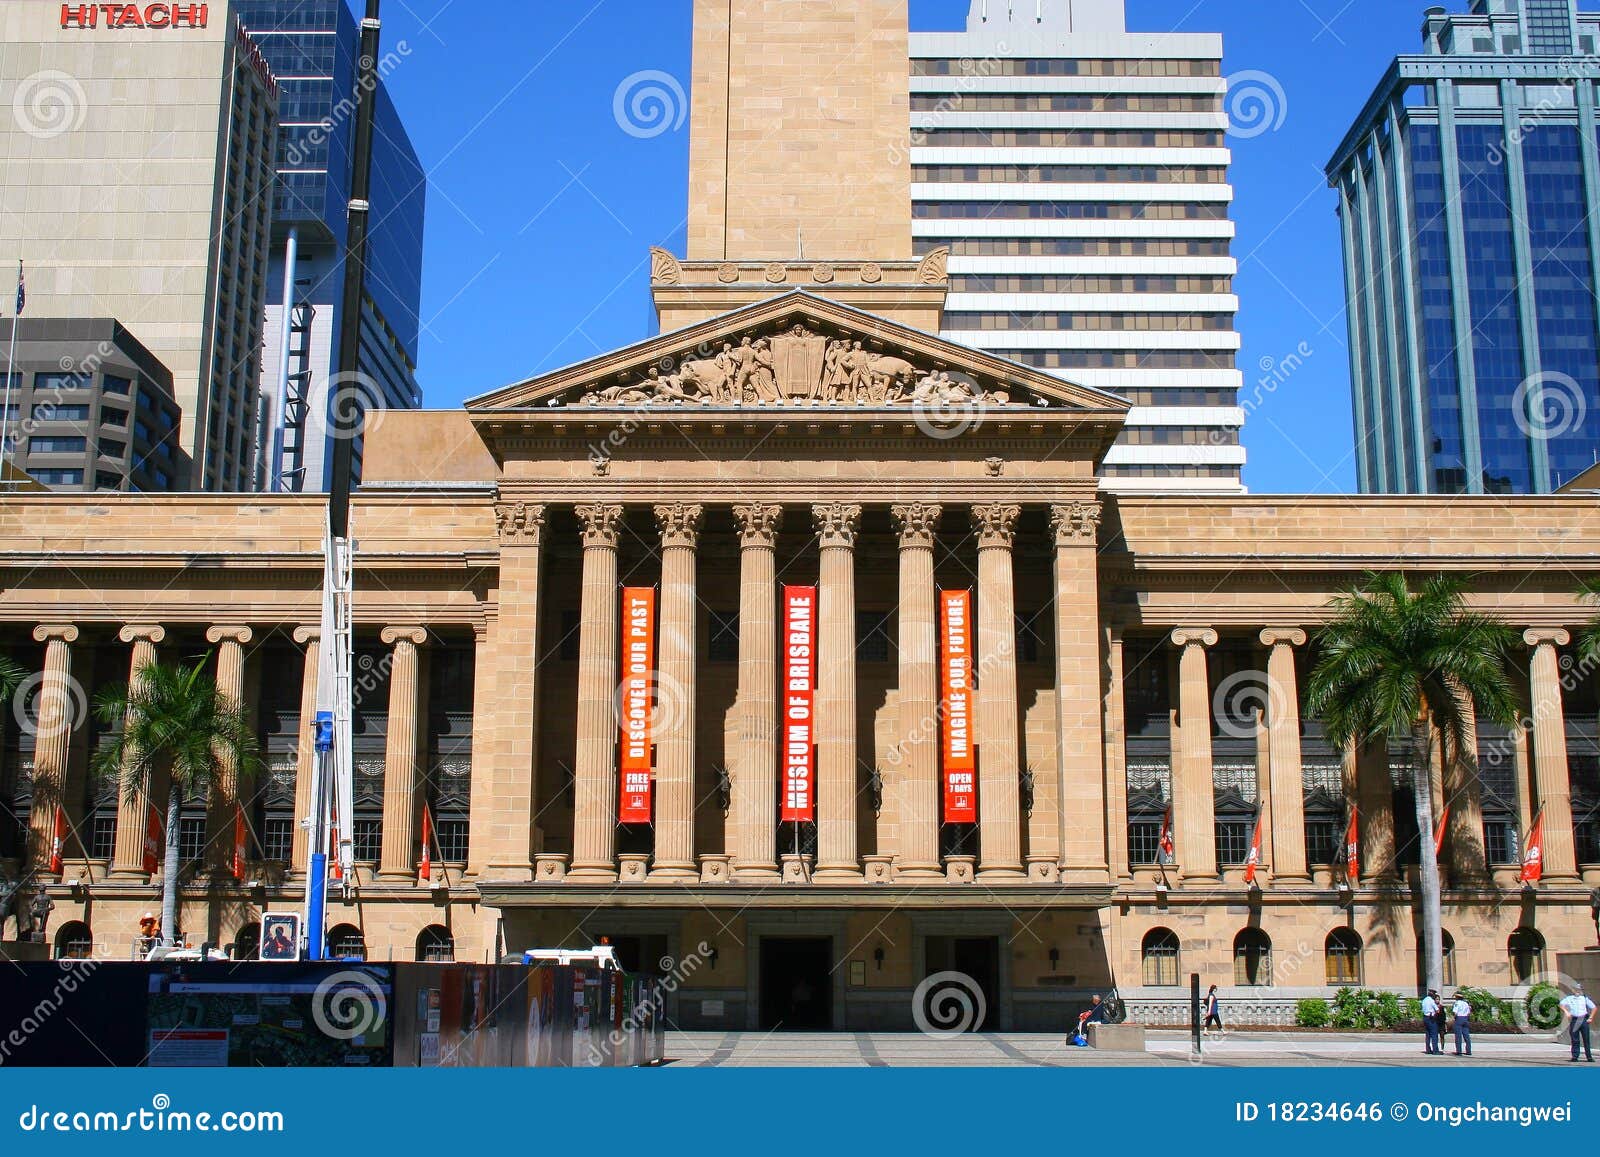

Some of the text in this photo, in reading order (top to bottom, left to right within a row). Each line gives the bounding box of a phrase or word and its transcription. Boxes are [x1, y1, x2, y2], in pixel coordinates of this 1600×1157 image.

[60, 3, 208, 28] HITACHI
[629, 599, 648, 758] DISCOVER OUR PAST
[947, 599, 967, 758] IMAGINE OUR FUTURE
[787, 598, 810, 809] MUSEUM OF BRISBANE
[626, 773, 648, 784] FREE
[949, 773, 972, 784] OPEN
[626, 784, 648, 793] ENTRY
[950, 784, 973, 793] 7 DAYS
